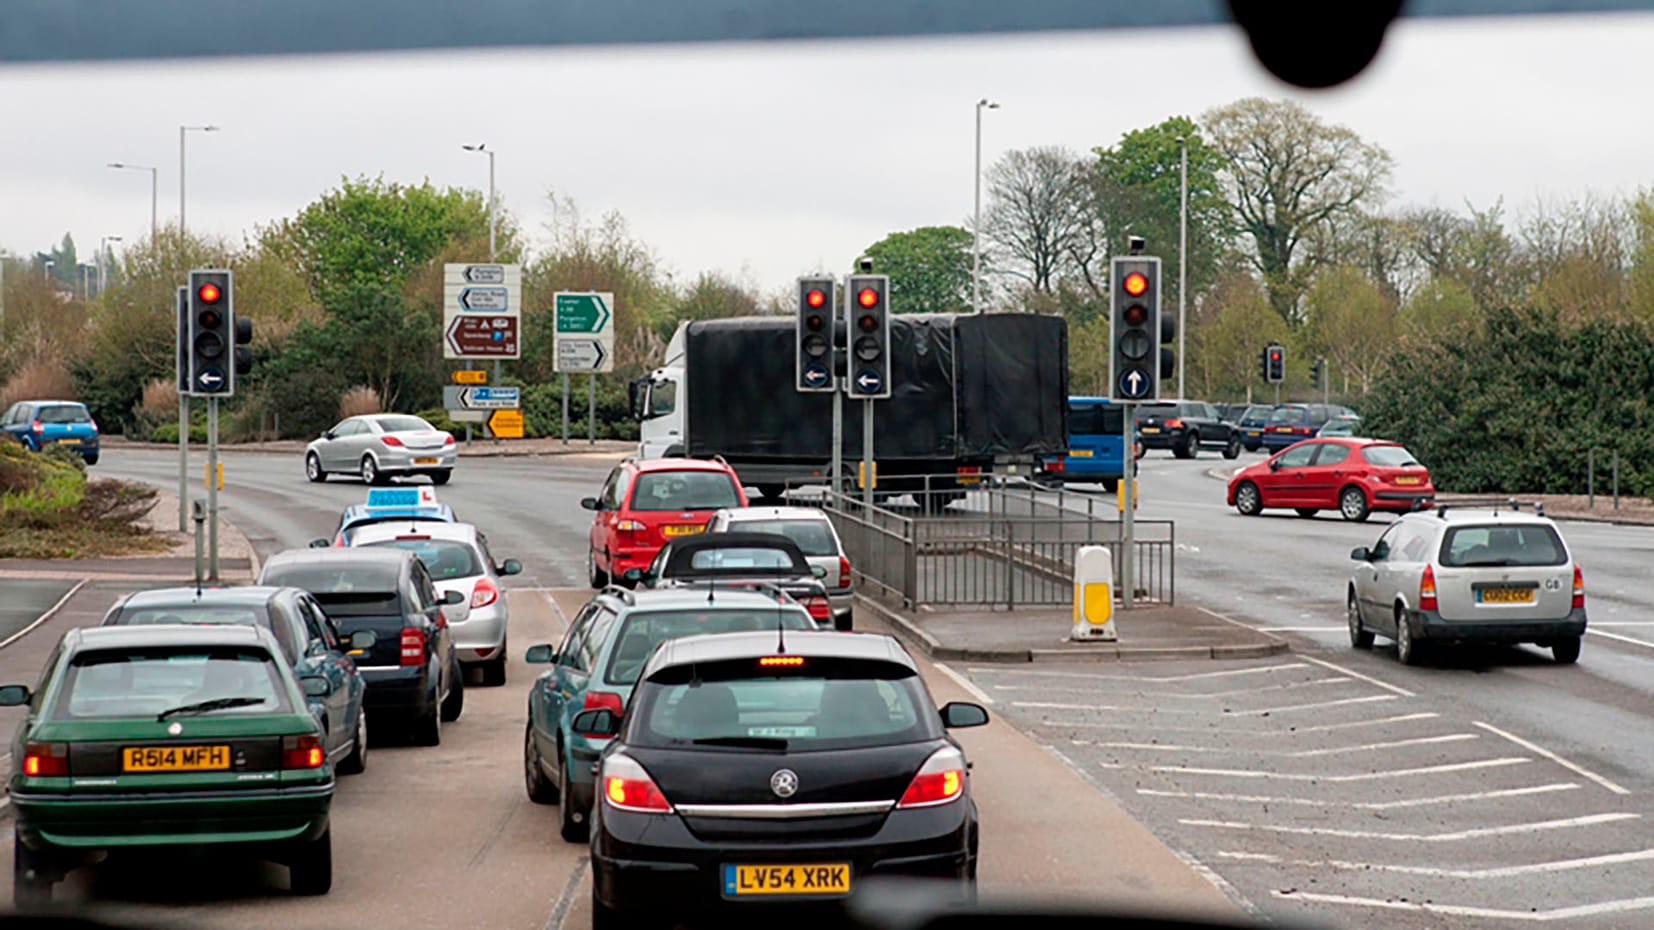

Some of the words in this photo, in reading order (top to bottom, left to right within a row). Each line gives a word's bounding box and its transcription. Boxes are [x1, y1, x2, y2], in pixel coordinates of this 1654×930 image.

[422, 490, 432, 501] L
[1545, 578, 1560, 590] GB
[131, 749, 177, 768] R514
[182, 747, 223, 766] MFH
[740, 867, 797, 889] LV54
[802, 866, 845, 888] XRK
